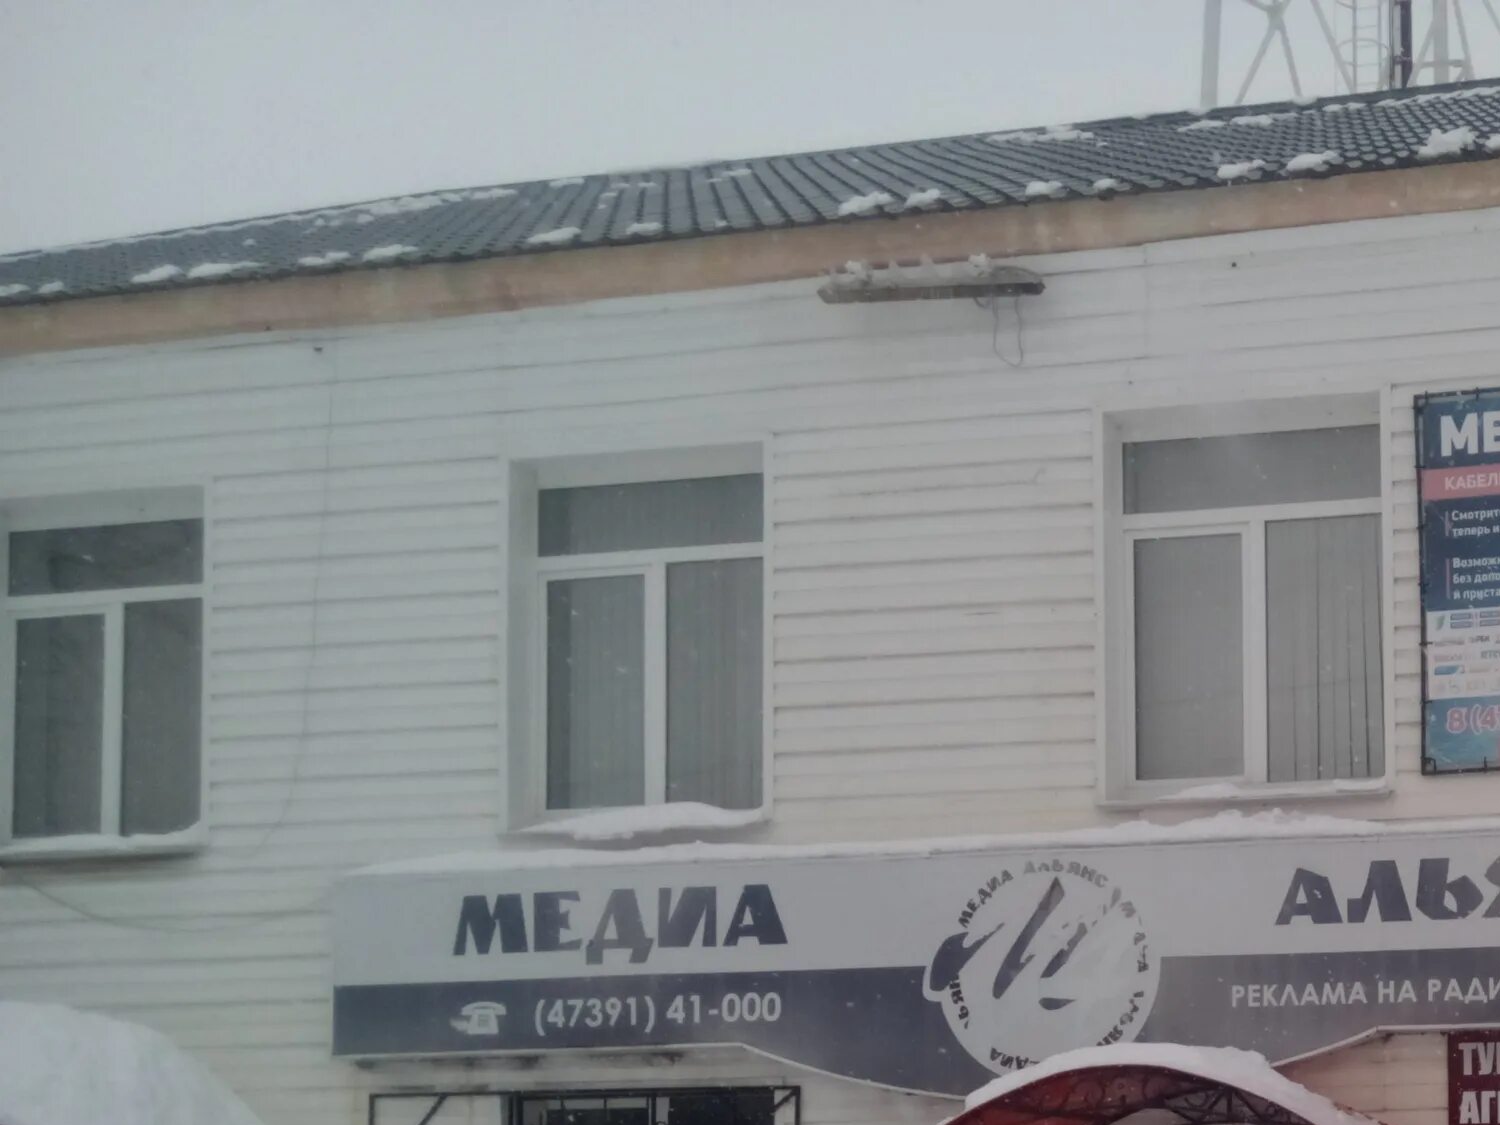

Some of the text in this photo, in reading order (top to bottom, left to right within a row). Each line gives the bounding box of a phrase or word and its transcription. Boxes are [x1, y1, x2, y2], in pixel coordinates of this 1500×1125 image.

[1452, 523, 1491, 538] теперь
[1492, 523, 1500, 534] и
[1452, 572, 1472, 585] без
[957, 869, 1014, 929] МЕДИА
[452, 883, 789, 965] МЕДИА
[1230, 980, 1369, 1010] РЕКЛАМА
[1377, 977, 1420, 1004] НА
[533, 991, 783, 1035] (47391) 41-000
